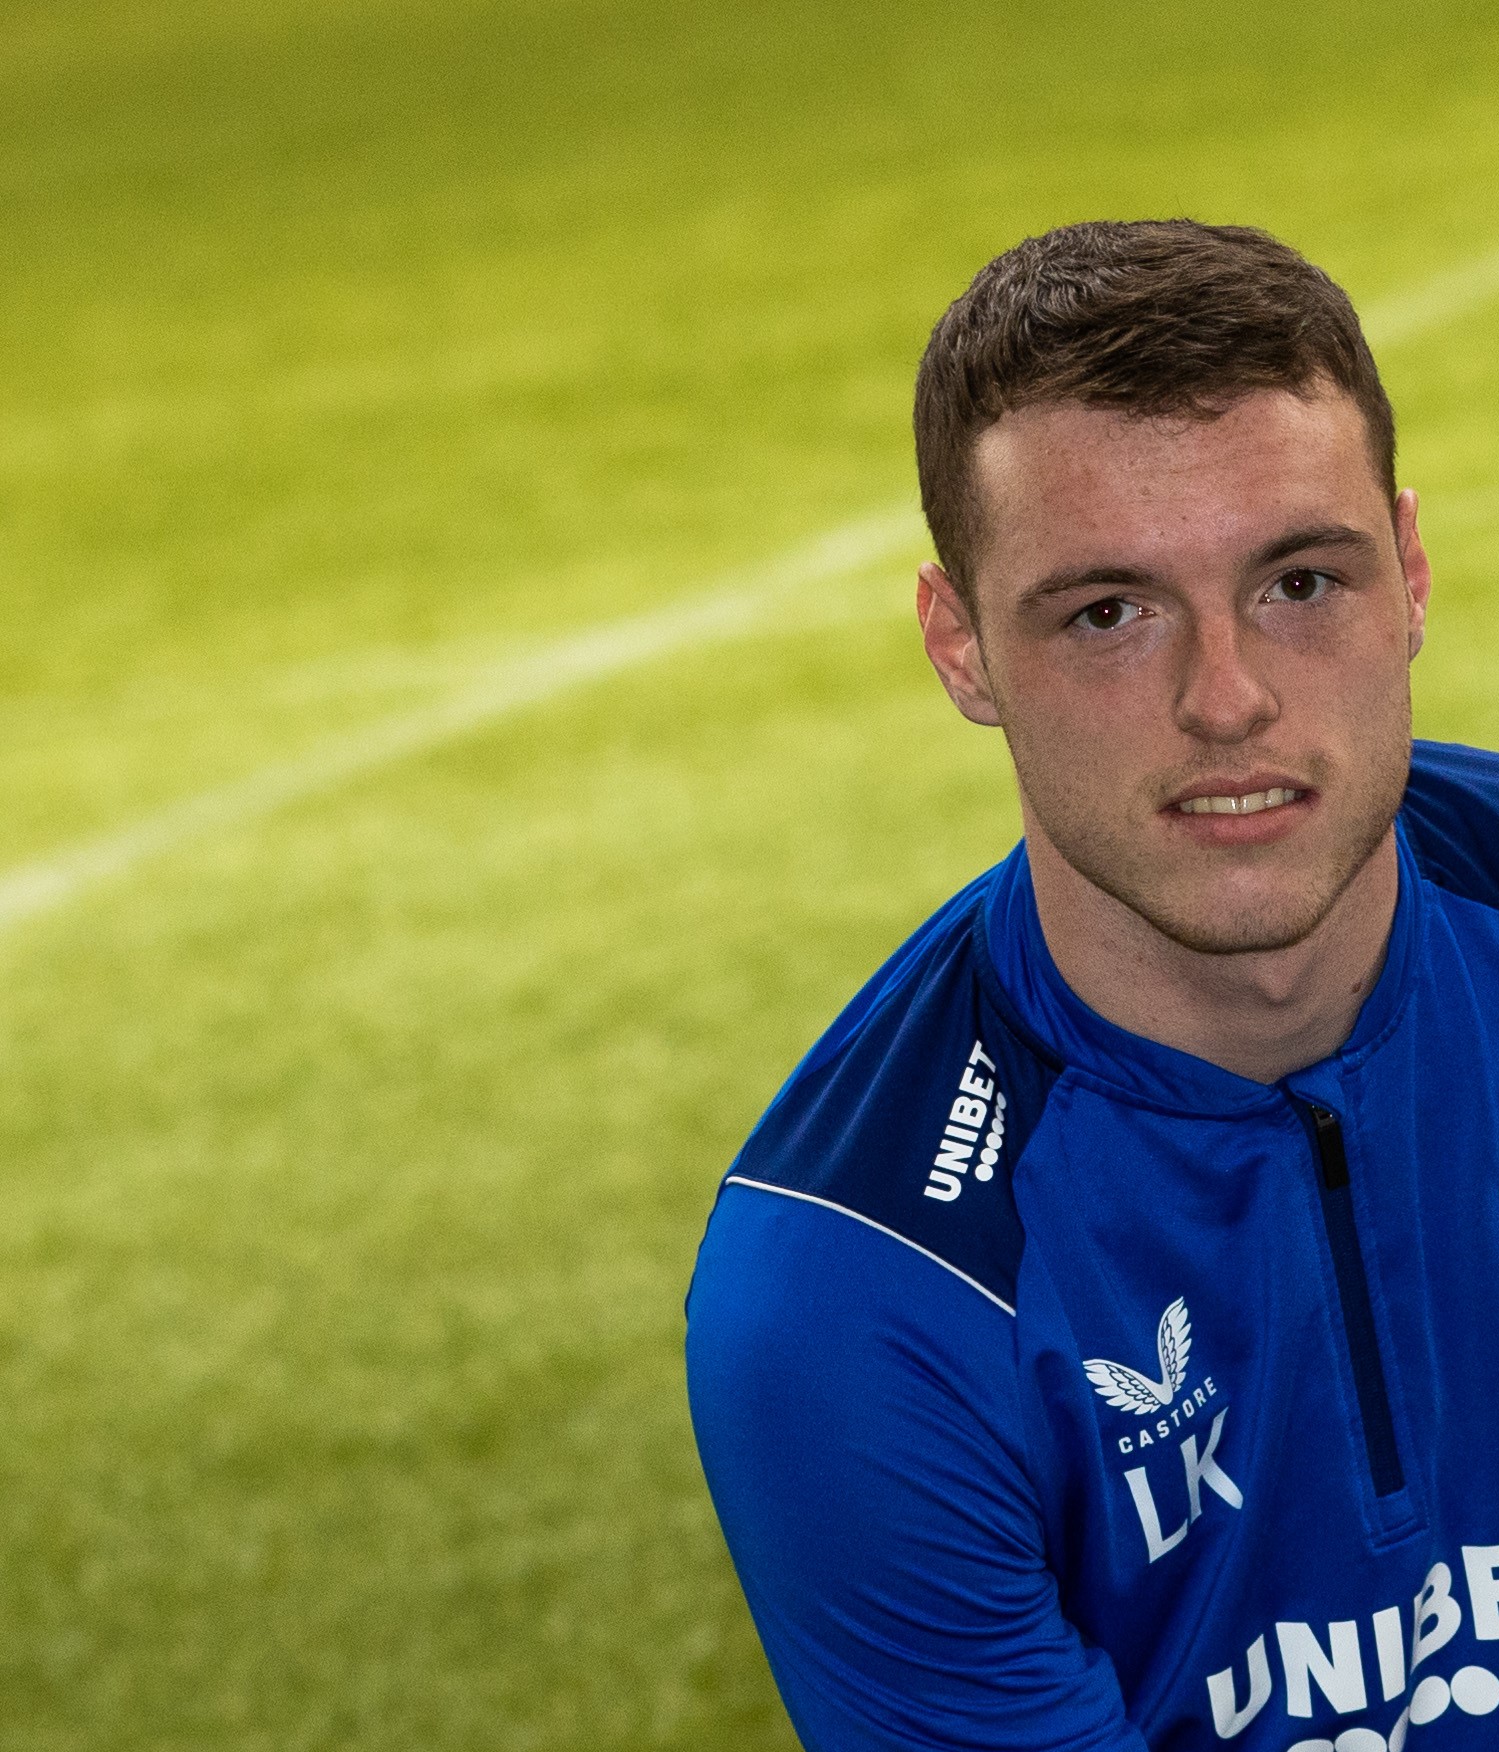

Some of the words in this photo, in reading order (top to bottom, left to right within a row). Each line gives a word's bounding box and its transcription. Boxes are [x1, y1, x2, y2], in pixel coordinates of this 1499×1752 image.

[924, 1040, 997, 1203] UNIBET
[1118, 1376, 1219, 1455] CASTORE
[1123, 1405, 1243, 1564] LK
